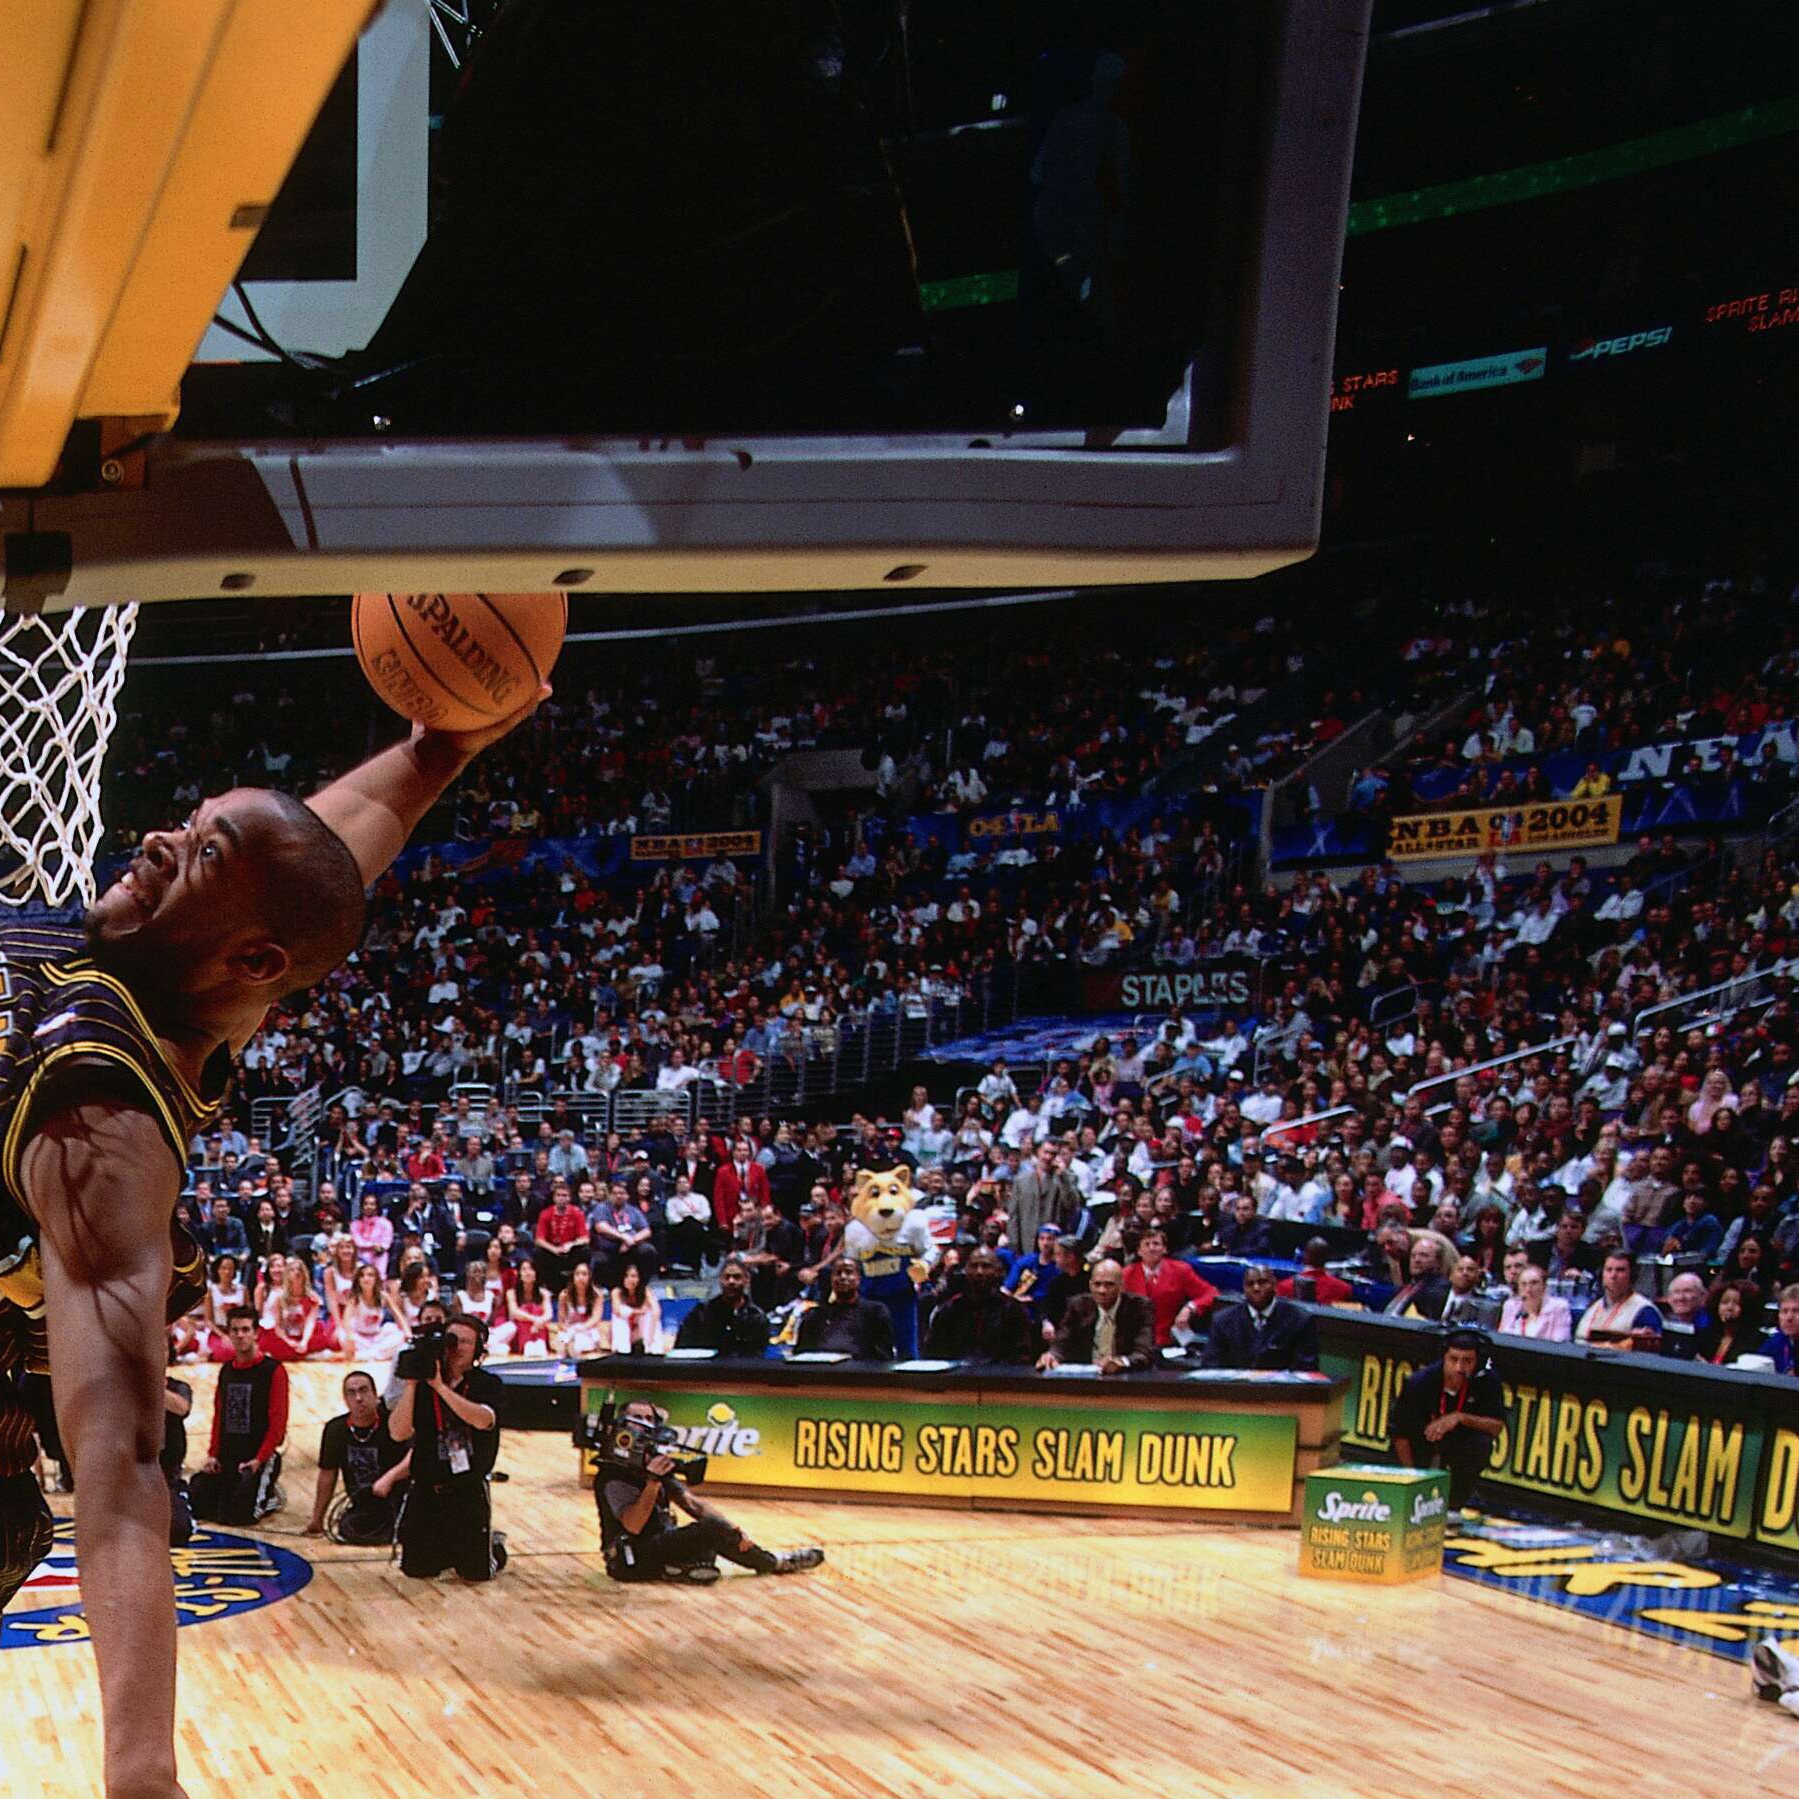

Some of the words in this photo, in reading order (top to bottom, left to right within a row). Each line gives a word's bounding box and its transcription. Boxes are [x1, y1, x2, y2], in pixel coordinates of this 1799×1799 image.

[1704, 293, 1770, 325] SPRITE
[1592, 325, 1673, 359] PEPSI
[1341, 367, 1400, 394] STARS
[1330, 394, 1355, 413] NK
[1393, 816, 1481, 841] NBA
[1529, 803, 1610, 831] 2004
[1120, 969, 1250, 1008] STAPLES
[794, 1417, 903, 1473] RISING
[915, 1423, 1019, 1478] STARS
[1032, 1428, 1126, 1483] SLAM
[1137, 1432, 1239, 1488] DUNK
[1619, 1406, 1745, 1524] SLAM
[1317, 1490, 1391, 1524] Sprite
[1310, 1525, 1350, 1549] RISING
[1353, 1529, 1392, 1552] STARS
[1313, 1549, 1347, 1569] SLAM
